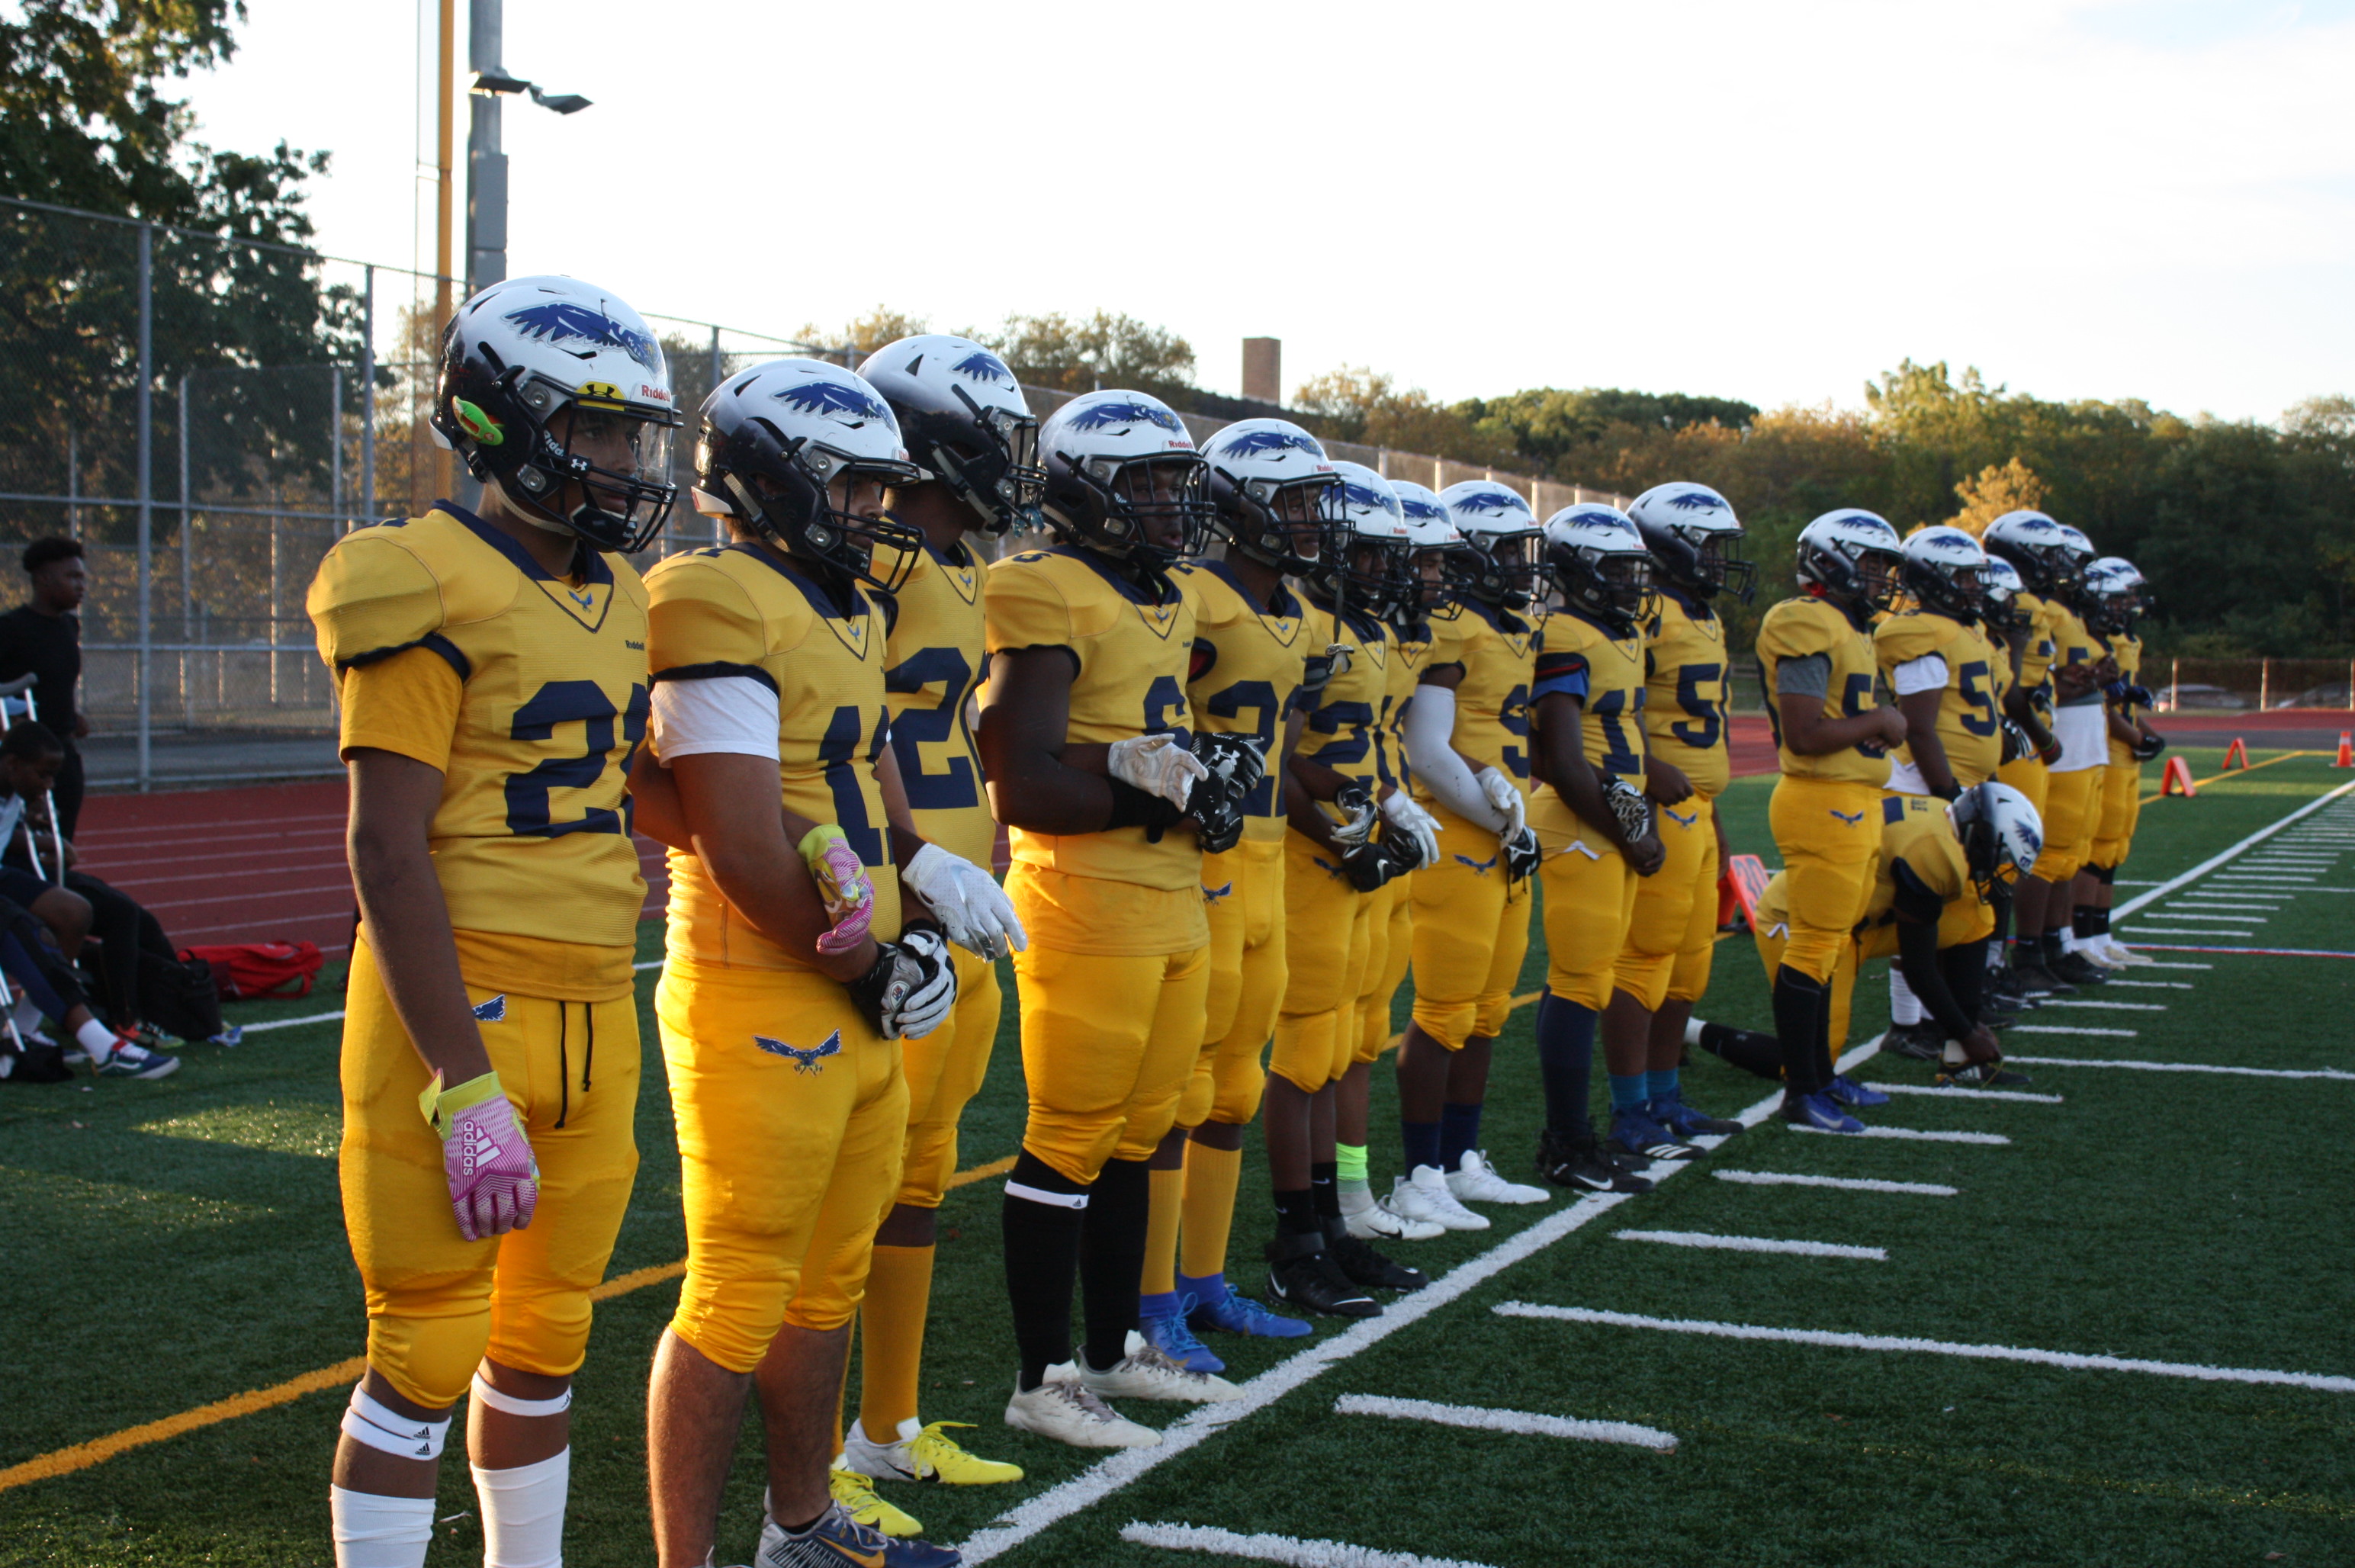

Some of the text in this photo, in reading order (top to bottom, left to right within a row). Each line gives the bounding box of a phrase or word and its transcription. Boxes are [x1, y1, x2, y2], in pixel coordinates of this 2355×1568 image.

[641, 384, 671, 402] Riddell
[544, 429, 564, 457] Ridd
[1592, 687, 1646, 776] 1
[463, 1120, 477, 1176] adidas
